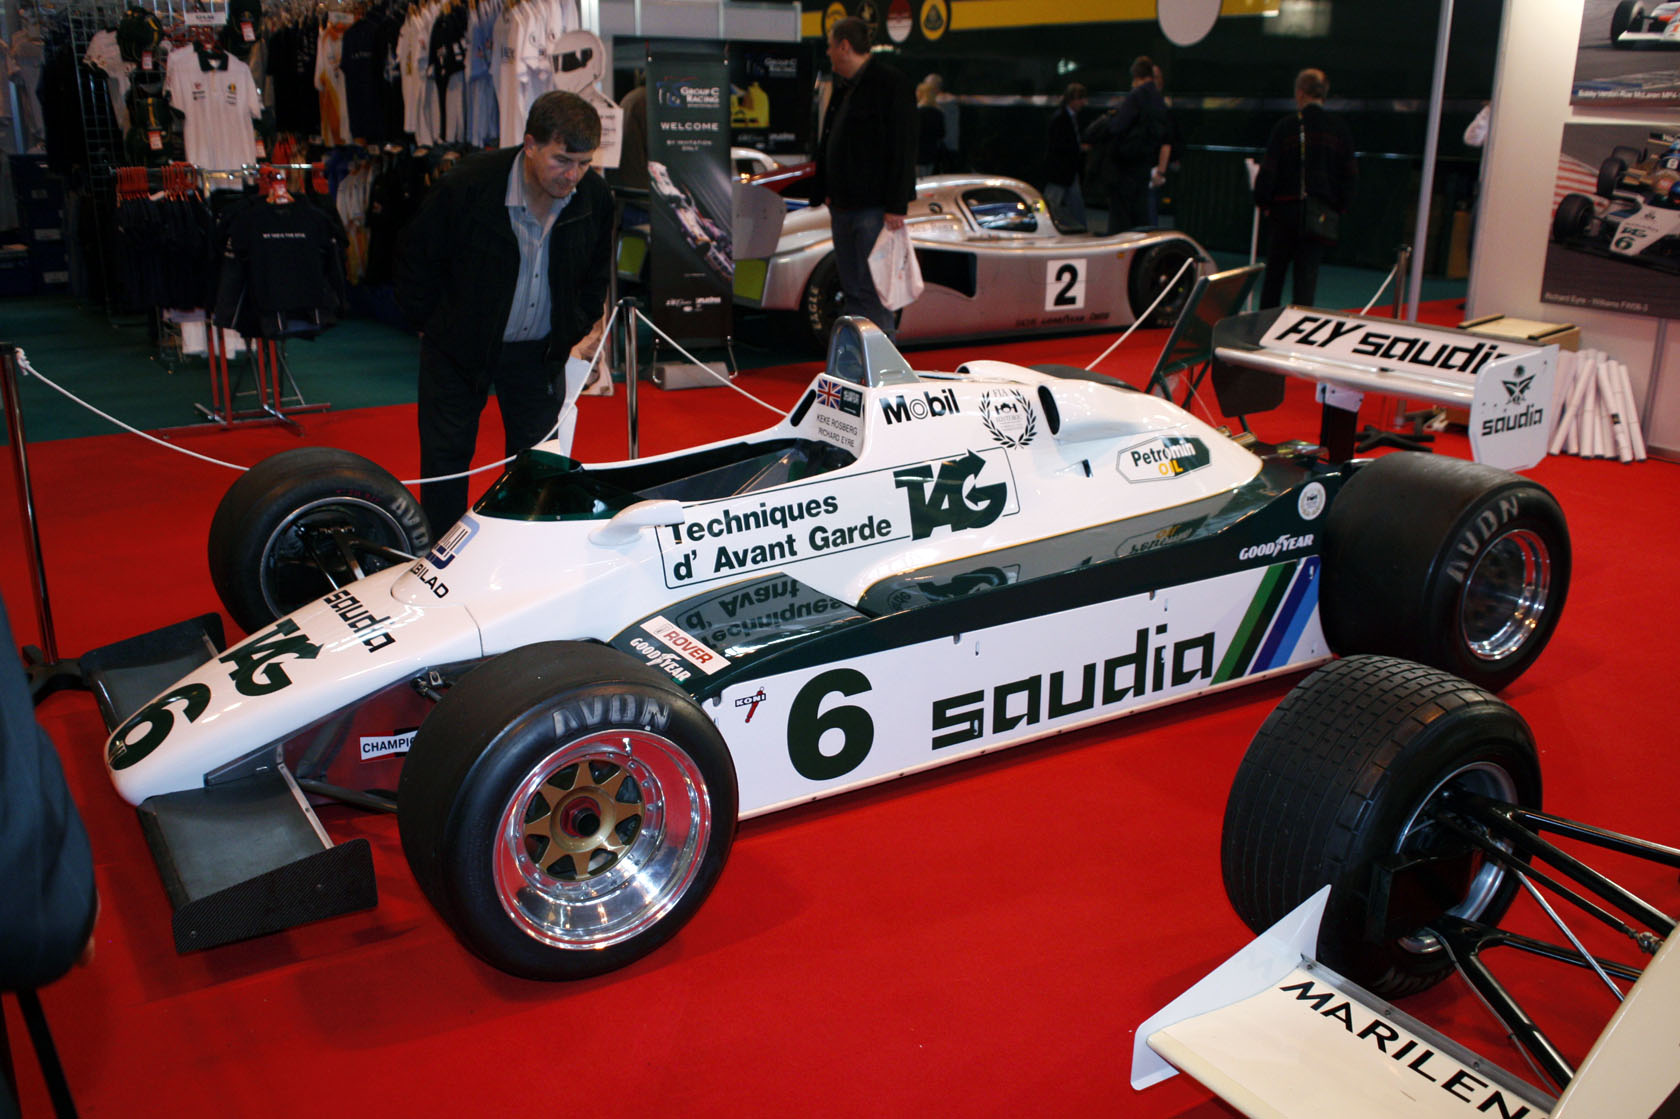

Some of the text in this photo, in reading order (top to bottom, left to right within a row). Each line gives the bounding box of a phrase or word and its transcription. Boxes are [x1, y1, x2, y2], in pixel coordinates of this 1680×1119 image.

[660, 121, 719, 131] WELCOME
[1053, 263, 1078, 306] 2
[1275, 315, 1366, 348] FLY
[816, 413, 858, 436] KEKE ROSBERG
[879, 387, 960, 425] Mobil
[1481, 405, 1543, 437] saudia
[818, 426, 856, 448] RICHARD EYRE
[1130, 441, 1197, 467] Petromin
[1157, 459, 1184, 476] OIL
[893, 448, 1007, 541] TAG
[666, 495, 839, 543] Techniques
[673, 515, 892, 581] d' Avant Garde
[1239, 533, 1314, 560] GOODYEAR
[323, 589, 396, 654] saudia
[219, 618, 324, 697] TAG
[629, 637, 692, 682] GOODYEAR
[663, 630, 714, 664] ROVER
[736, 693, 766, 707] KONI
[932, 623, 1215, 750] saudia
[107, 683, 211, 771] 6
[553, 694, 673, 738] AVON
[787, 667, 874, 781] 6
[1280, 981, 1548, 1119] MARILEN
